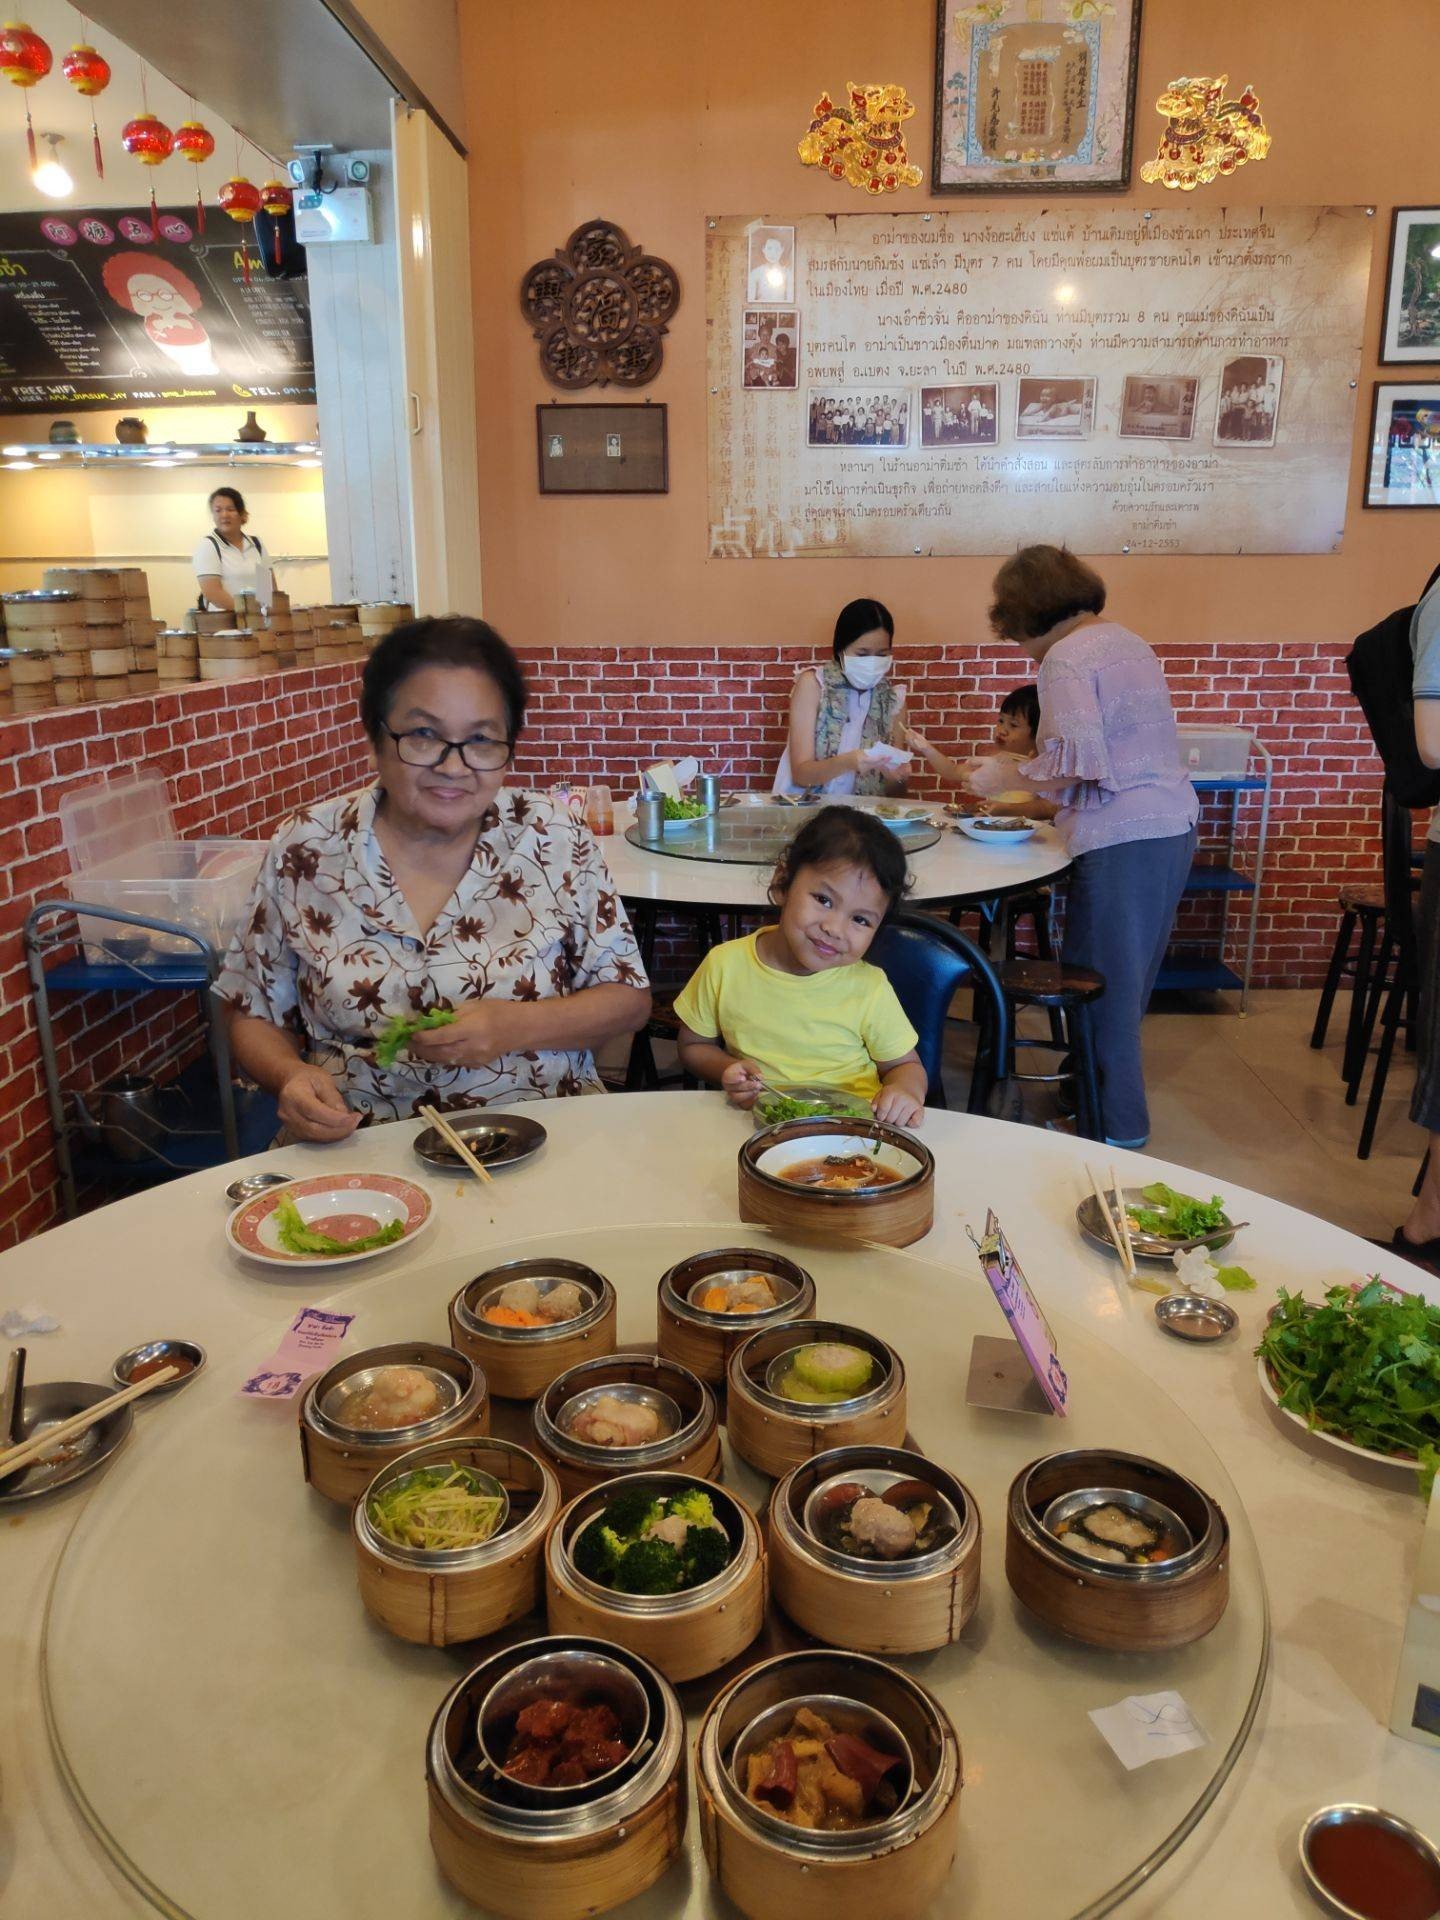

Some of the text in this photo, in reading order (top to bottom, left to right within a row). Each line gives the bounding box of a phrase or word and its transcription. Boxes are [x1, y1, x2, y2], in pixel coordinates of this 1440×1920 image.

[872, 224, 954, 245] อาม่าของผมชื่อ
[1219, 222, 1275, 241] ประเทศจีน
[954, 251, 983, 274] มีบุตร
[992, 257, 998, 269] 7
[1007, 257, 1022, 269] คน
[806, 278, 968, 298] ในเมืองไทย เมื่อปี พ.ศ.2480
[957, 306, 1049, 327] คืออาม่าของดิฉัน
[1056, 305, 1130, 329] ท่านมีบุตรรวม
[1137, 311, 1145, 323] 8
[1153, 311, 1169, 323] คน
[1177, 303, 1275, 327] คุณแม่ของดิฉันเป็น
[806, 336, 857, 358] บุตรคนโต
[807, 357, 1031, 383] อพยพสู่ อ.เบตง จ.ยะลา ในปี พ.ศ.2480
[250, 388, 280, 396] TEL.
